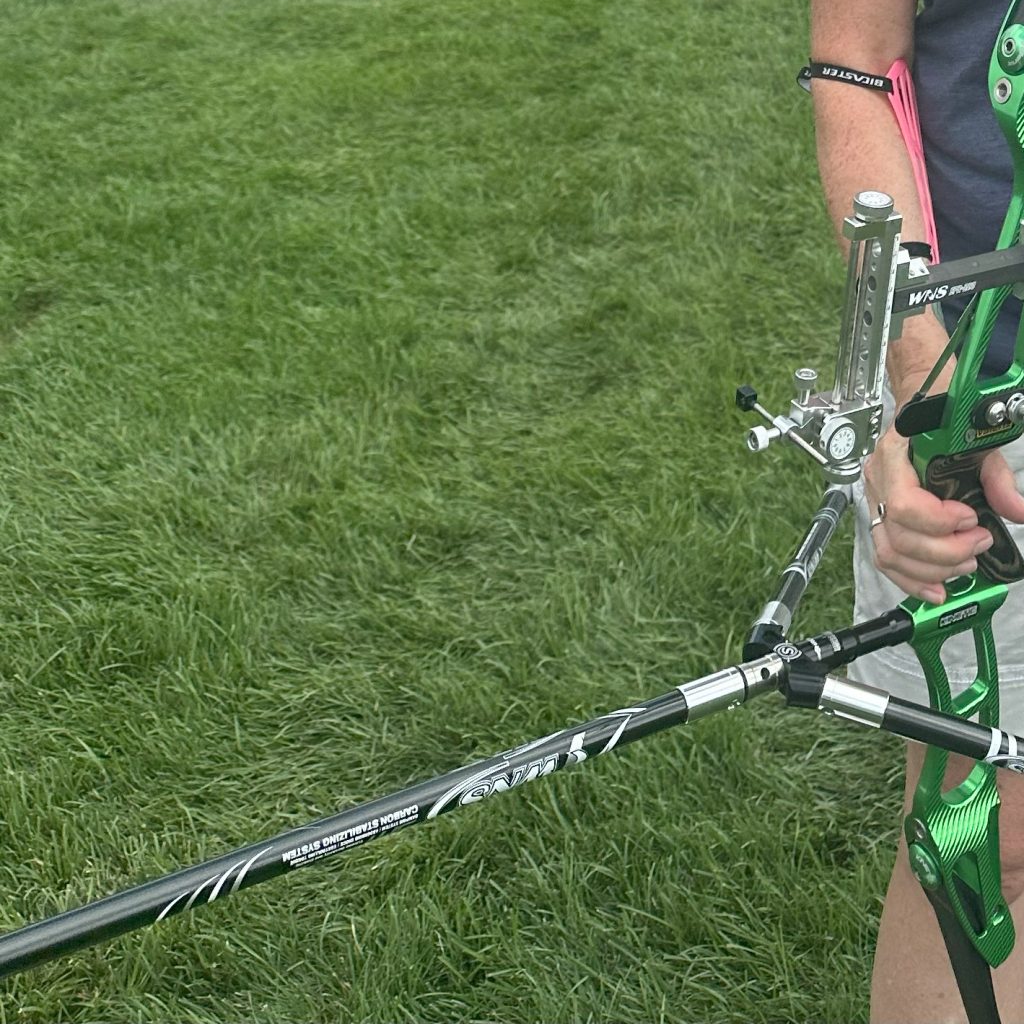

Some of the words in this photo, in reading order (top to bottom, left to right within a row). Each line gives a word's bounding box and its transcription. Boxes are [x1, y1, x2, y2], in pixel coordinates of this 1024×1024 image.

[908, 285, 948, 306] WNS
[380, 804, 419, 827] CARBON
[322, 817, 380, 849] STABILIZING
[282, 840, 322, 863] SYSTEM
